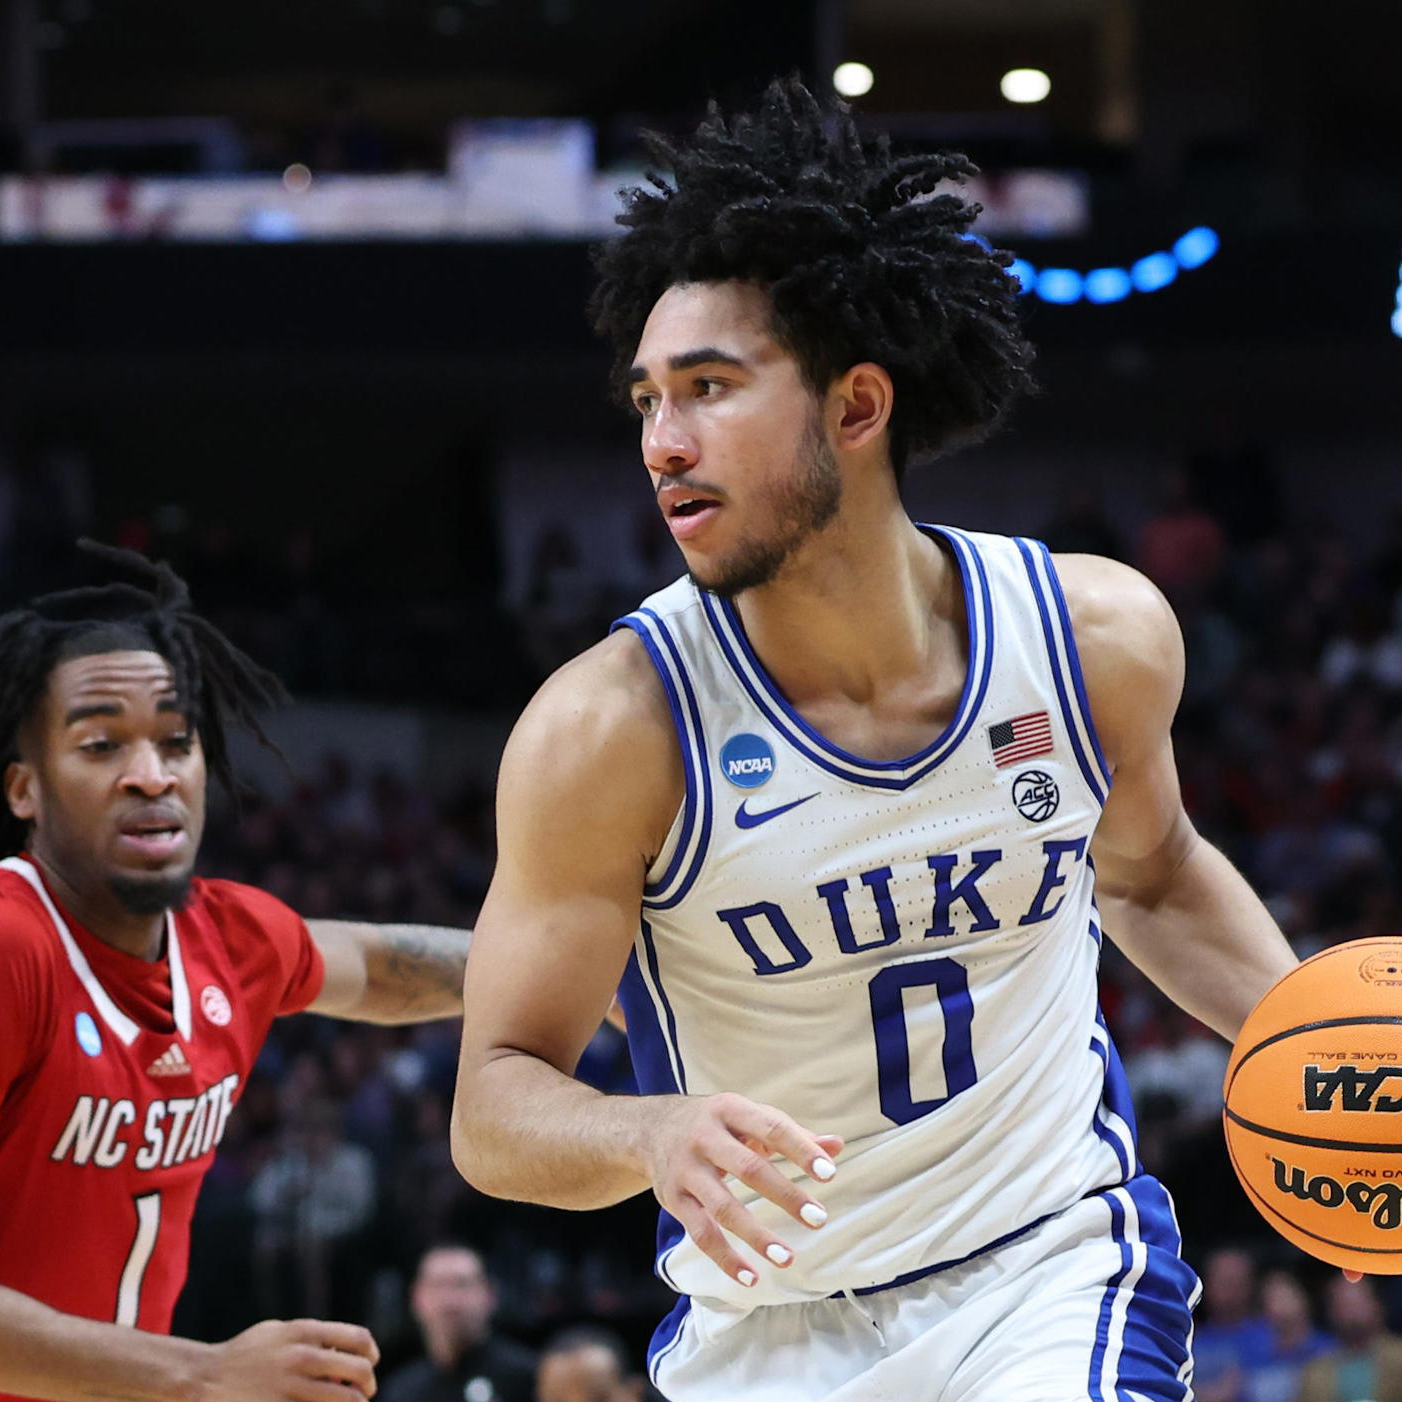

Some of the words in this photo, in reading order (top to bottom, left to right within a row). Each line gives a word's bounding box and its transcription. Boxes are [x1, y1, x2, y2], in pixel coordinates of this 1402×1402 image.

[728, 757, 773, 776] NCAA
[717, 836, 1088, 976] DUKE
[868, 956, 979, 1126] 0
[1306, 1051, 1347, 1061] BALL
[1350, 1051, 1398, 1062] GAME
[50, 1095, 136, 1168] NC
[134, 1073, 239, 1170] STATE
[1344, 1167, 1377, 1179] NXT
[113, 1190, 161, 1328] 1
